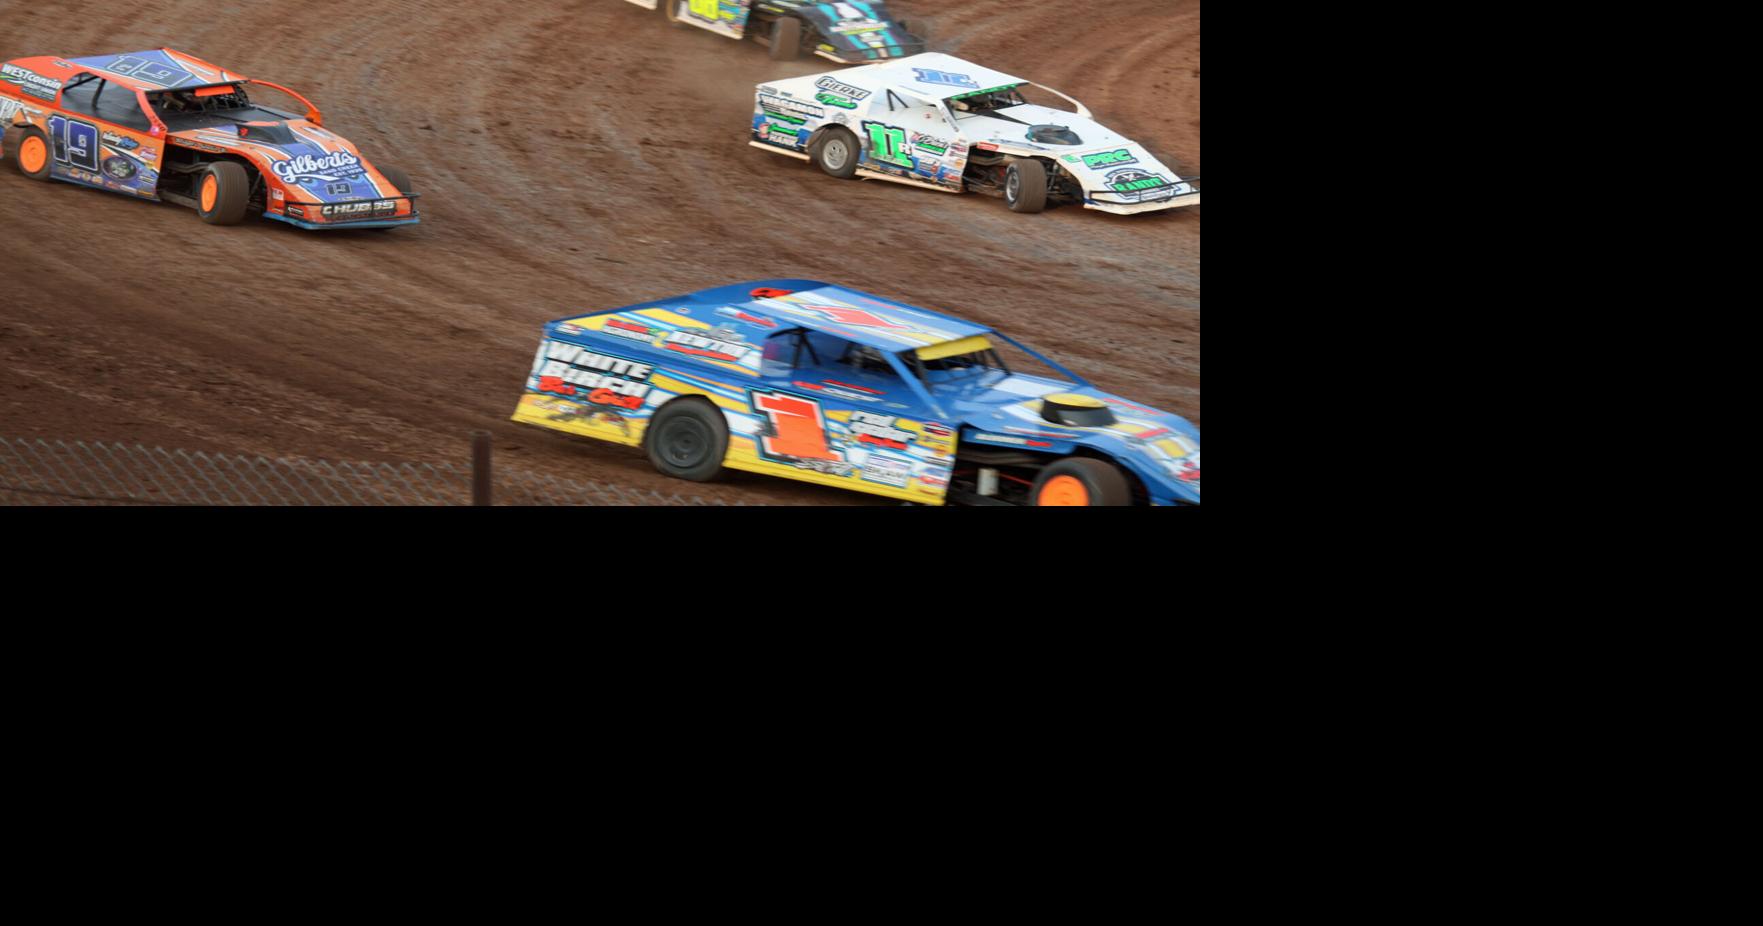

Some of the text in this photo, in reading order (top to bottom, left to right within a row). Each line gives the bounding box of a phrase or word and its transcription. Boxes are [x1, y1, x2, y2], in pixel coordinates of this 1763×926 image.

[1, 64, 62, 89] WESTconsin
[816, 77, 867, 99] GIERKE
[48, 115, 98, 172] 19
[1081, 149, 1132, 166] PRC
[273, 152, 357, 183] Gilberts
[546, 340, 651, 379] WHITE
[749, 389, 845, 462] 1
